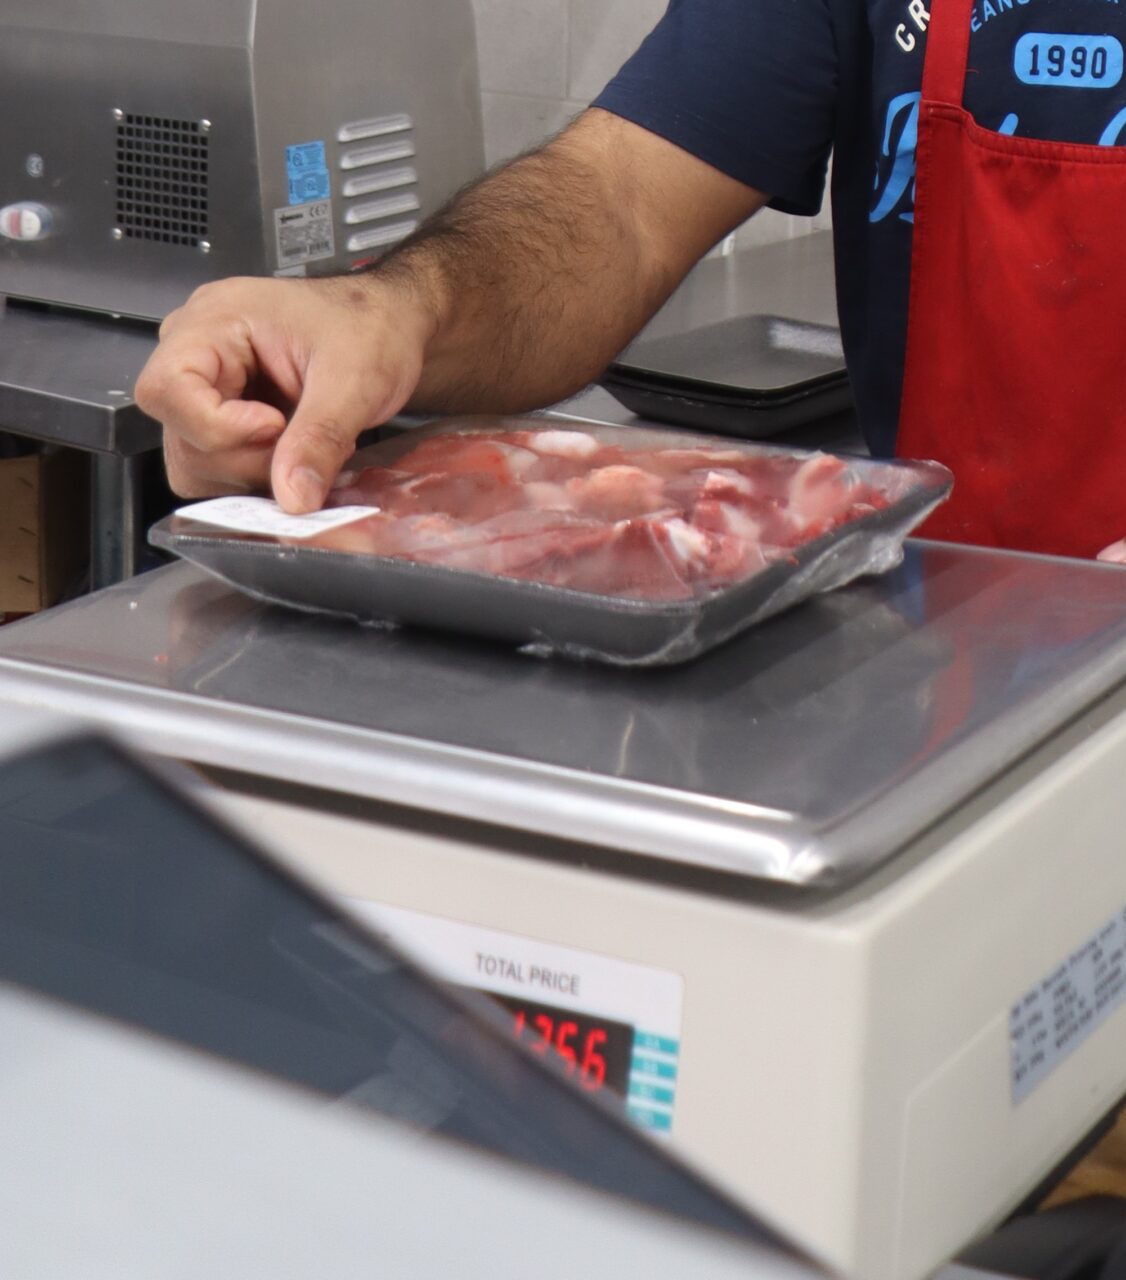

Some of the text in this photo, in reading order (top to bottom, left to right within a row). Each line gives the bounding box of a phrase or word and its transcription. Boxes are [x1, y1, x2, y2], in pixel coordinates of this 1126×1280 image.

[1029, 44, 1107, 79] 1990
[476, 953, 579, 995] TOTAL PRICE
